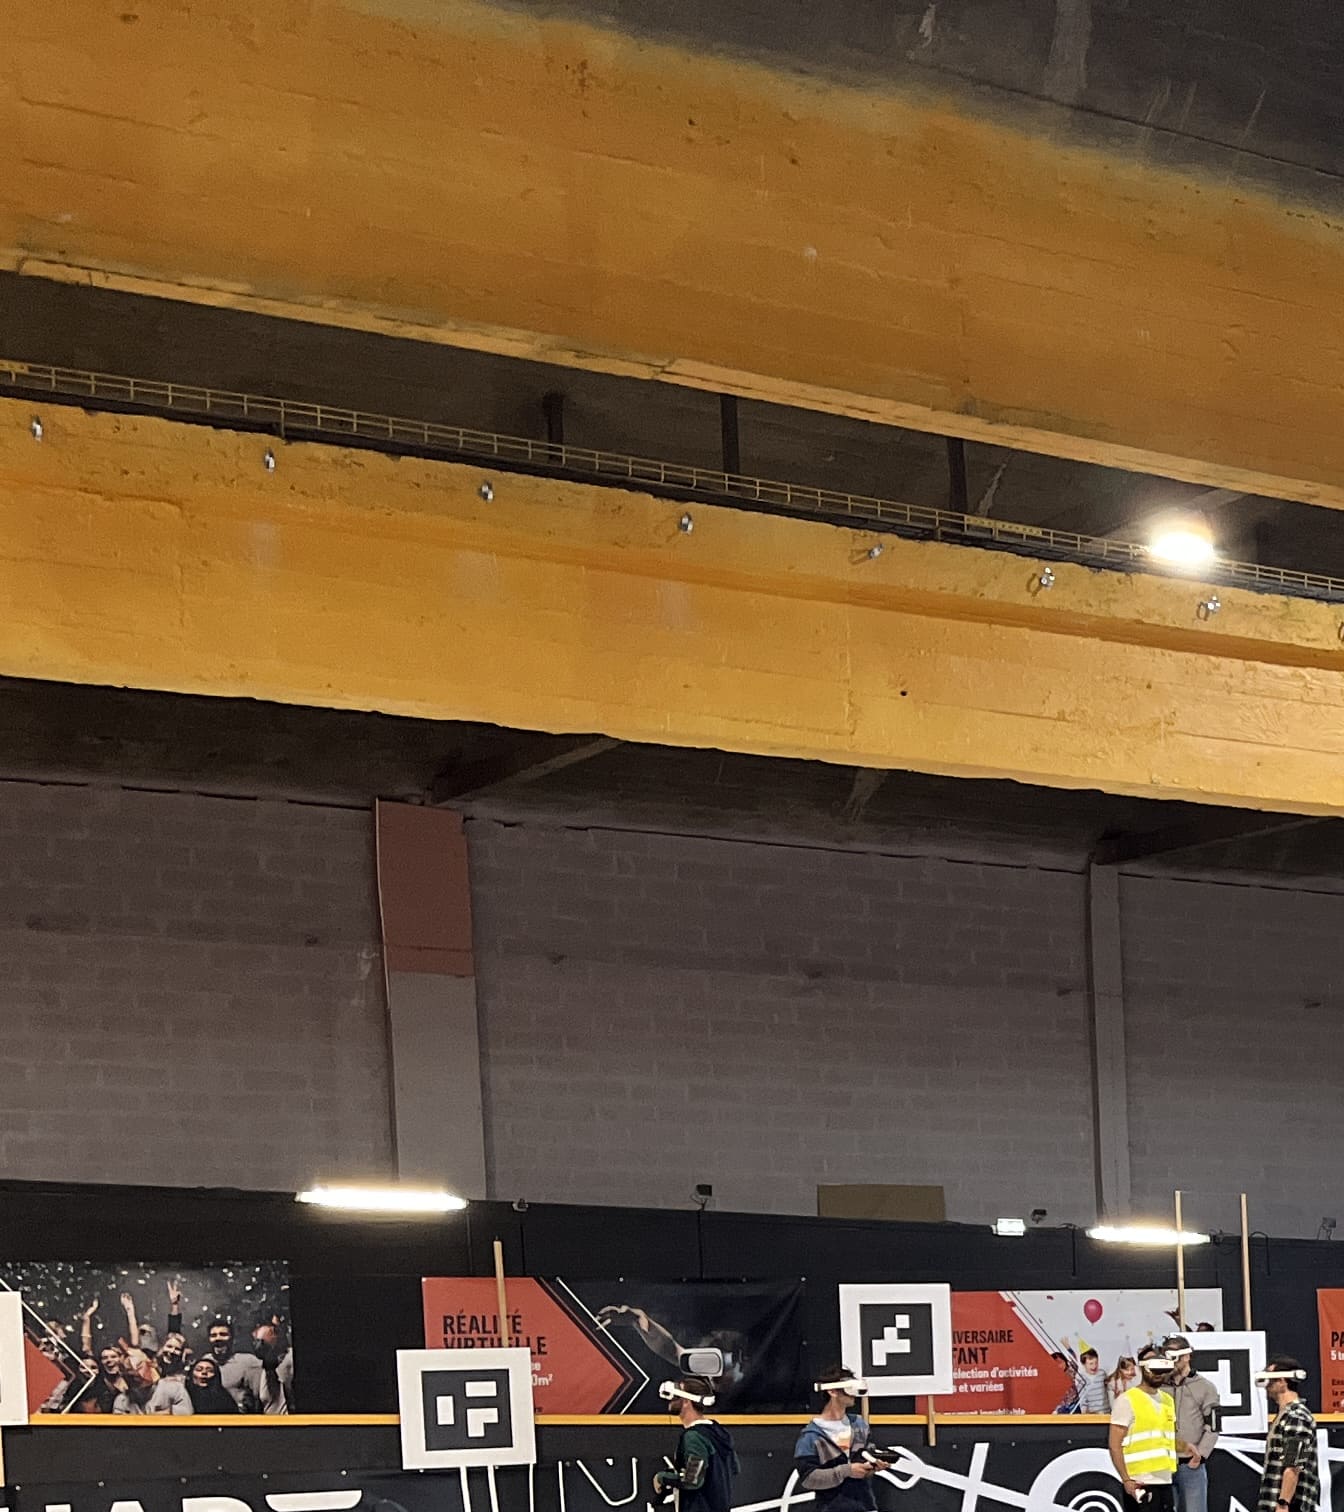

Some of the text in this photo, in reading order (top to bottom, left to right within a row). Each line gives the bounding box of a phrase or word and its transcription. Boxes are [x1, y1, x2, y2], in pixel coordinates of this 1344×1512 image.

[443, 1309, 522, 1335] RÉALIÉ
[1330, 1349, 1337, 1360] 5
[990, 1365, 1038, 1378] d'activités
[958, 1382, 969, 1392] et
[970, 1380, 1004, 1392] variées
